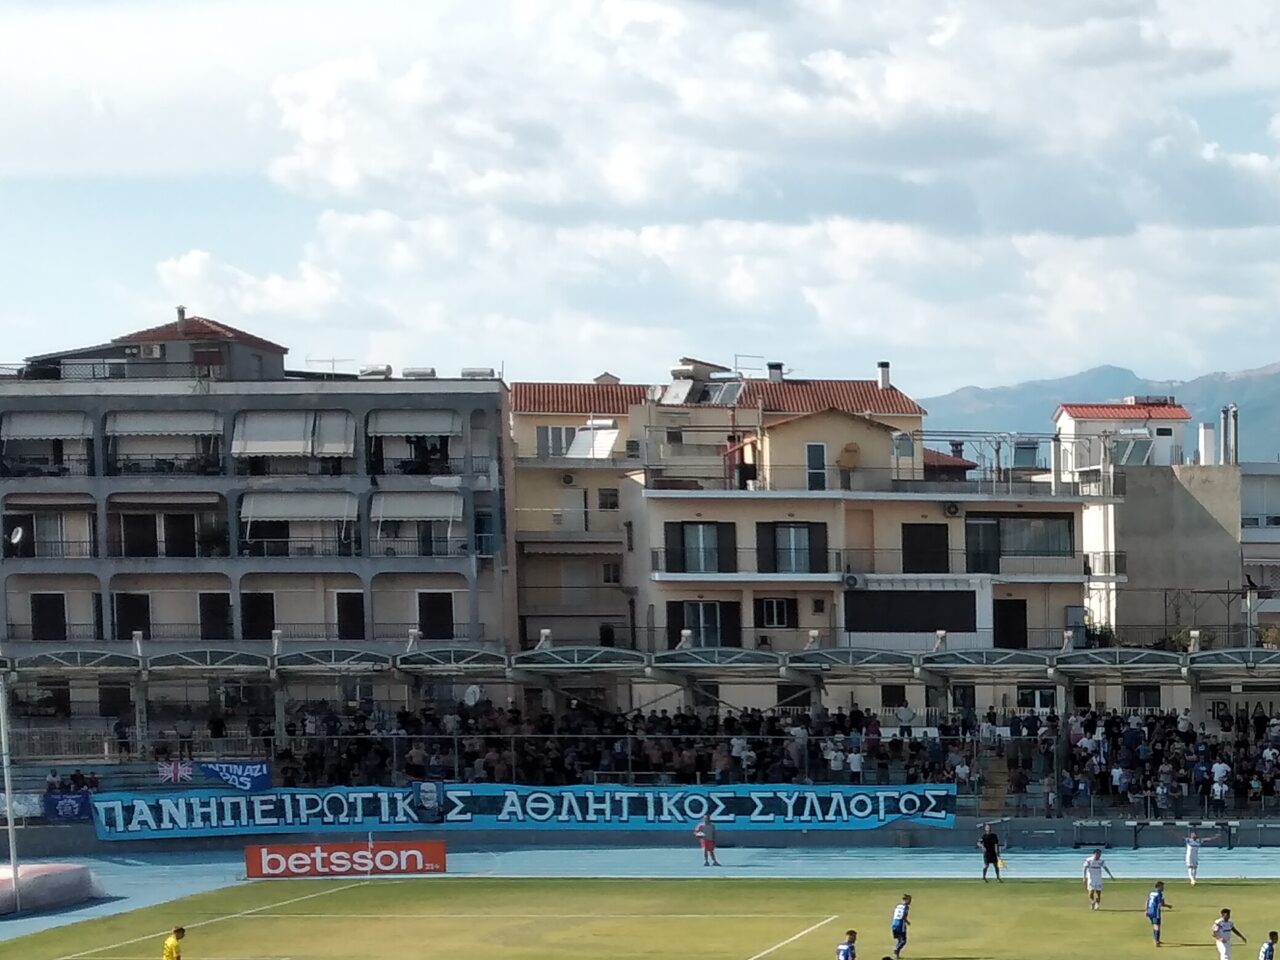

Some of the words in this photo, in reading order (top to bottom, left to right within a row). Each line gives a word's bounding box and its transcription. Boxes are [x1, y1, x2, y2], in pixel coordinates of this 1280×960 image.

[201, 763, 268, 777] NTINAZI
[97, 790, 473, 834] ΠΑΝΗΠΕΙΡΩΤΙΚΣ
[498, 790, 736, 822] ΑΘΛΗΤΙΚΟΣ
[750, 789, 950, 821] ΣΥΛΛΟΓΟΣ
[261, 846, 423, 874] betsson
